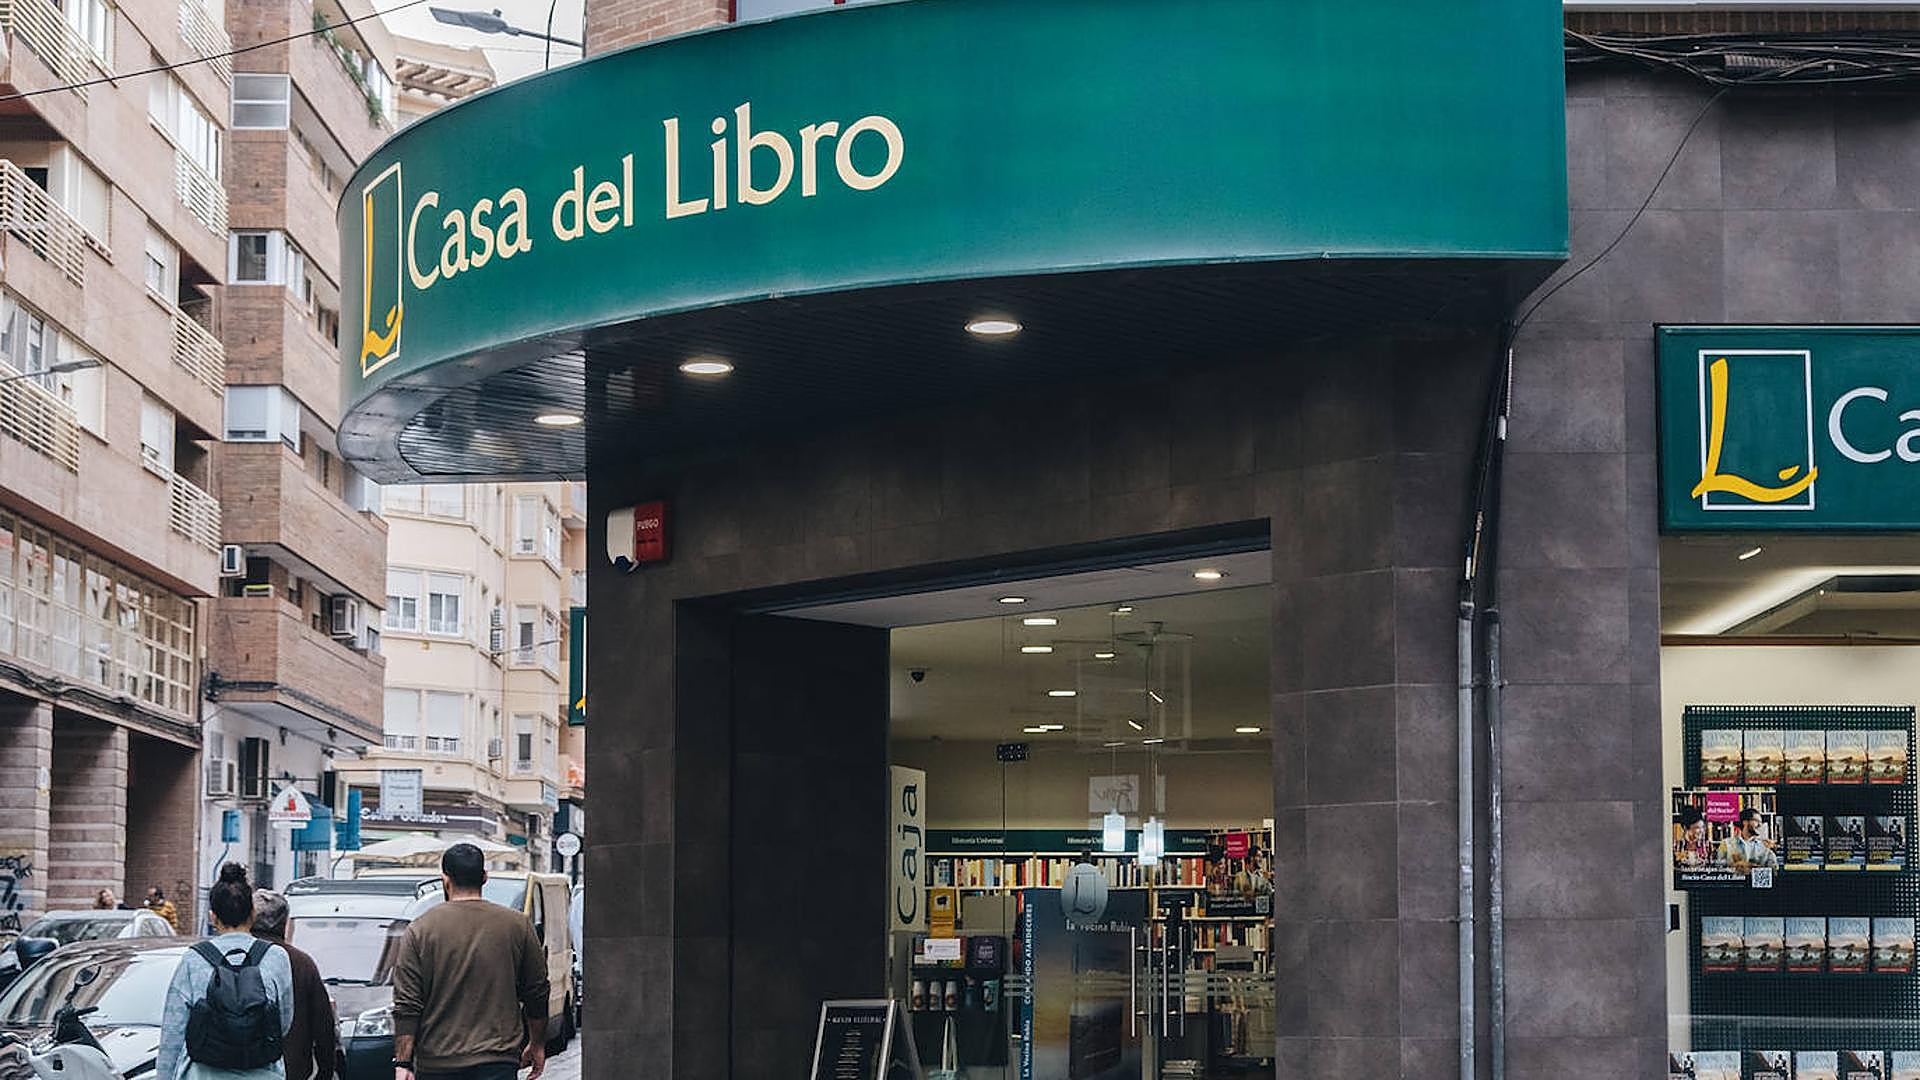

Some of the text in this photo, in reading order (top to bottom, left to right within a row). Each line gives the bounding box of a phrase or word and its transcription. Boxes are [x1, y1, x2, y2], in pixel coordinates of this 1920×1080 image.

[407, 101, 904, 290] Casa del Libro
[897, 783, 922, 925] Caja
